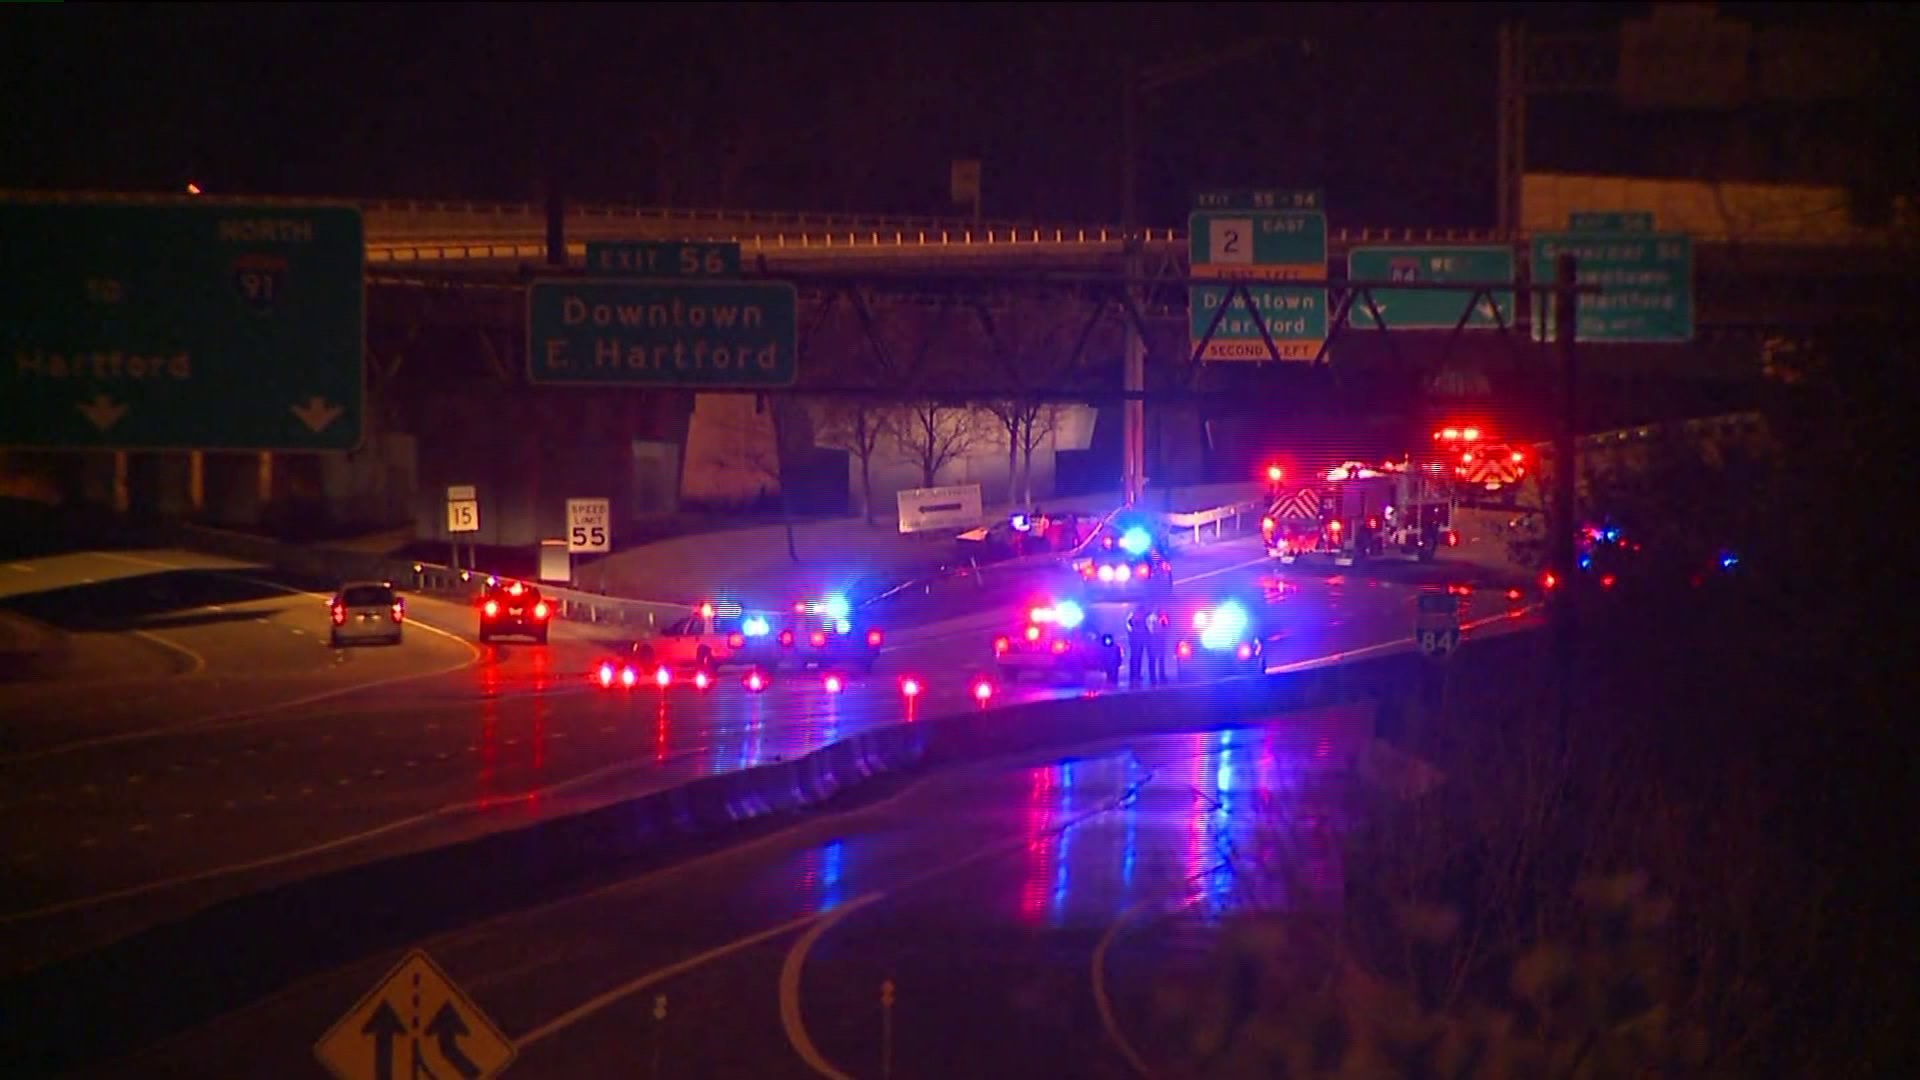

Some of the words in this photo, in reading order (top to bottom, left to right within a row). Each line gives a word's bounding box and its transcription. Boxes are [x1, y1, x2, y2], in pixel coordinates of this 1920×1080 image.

[218, 219, 313, 241] NORTH
[1262, 219, 1305, 233] EAST
[1223, 229, 1239, 253] 2
[598, 248, 657, 269] EXIT
[679, 246, 725, 272] 56
[239, 273, 274, 300] 91
[561, 296, 762, 327] Downtown
[594, 337, 778, 369] Hartford
[1210, 347, 1264, 356] SECOND
[1278, 346, 1309, 356] EFT
[15, 351, 192, 379] Hartford
[454, 506, 472, 525] 15
[572, 503, 606, 516] SPEED
[575, 517, 603, 528] LIMIT
[573, 528, 606, 546] 55
[1422, 631, 1452, 656] 84
